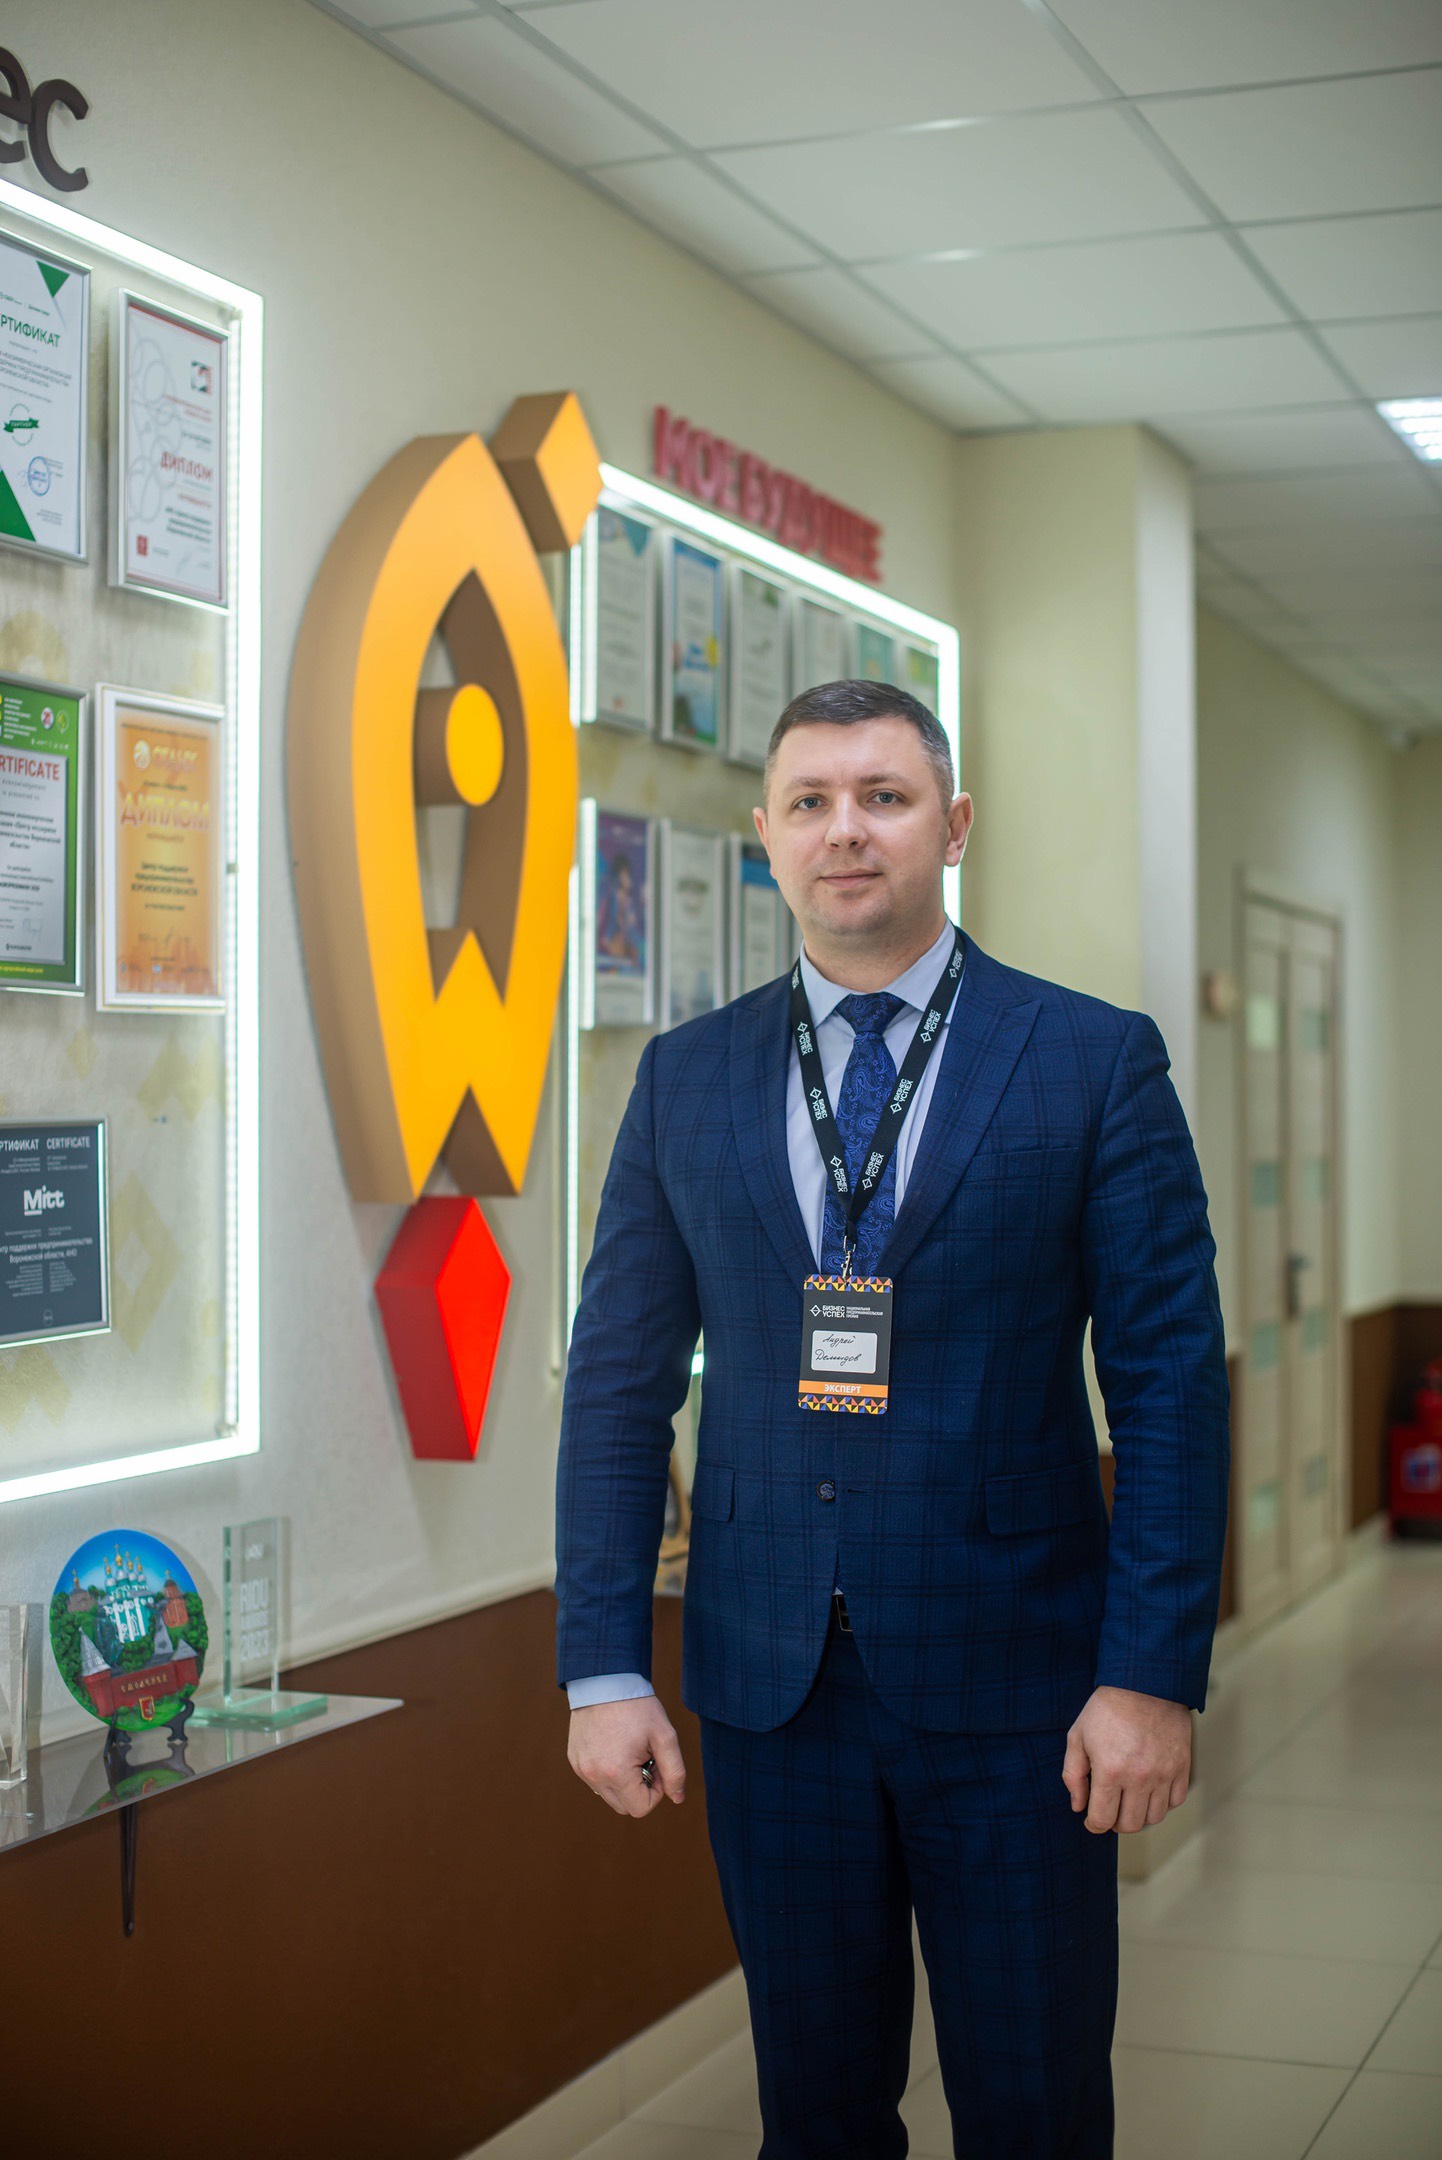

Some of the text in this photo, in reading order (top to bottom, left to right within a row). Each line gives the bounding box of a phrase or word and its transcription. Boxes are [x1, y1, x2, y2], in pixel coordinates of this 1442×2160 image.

[161, 451, 212, 481] ДИПЛОМ
[120, 794, 209, 830] ДИПЛОМ
[923, 1009, 936, 1031] БИЗНЕС
[929, 1012, 942, 1033] УСПЕХ
[798, 1033, 808, 1056] УСПЕХ
[893, 1078, 907, 1101] БИЗНЕС
[899, 1080, 914, 1102] УСПЕХ
[812, 1100, 823, 1121] УСПЕХ
[46, 1136, 90, 1150] CERTIFICATE
[864, 1151, 878, 1176] БИЗНЕС
[870, 1153, 885, 1178] УСПЕХ
[833, 1168, 844, 1192] УСПЕХ
[23, 1184, 65, 1211] Mitt
[822, 1304, 846, 1312] БИЗНЕС
[822, 1333, 857, 1348] Андрей
[815, 1348, 862, 1366] Демидов
[823, 1384, 862, 1394] ЭКСПЕРТ
